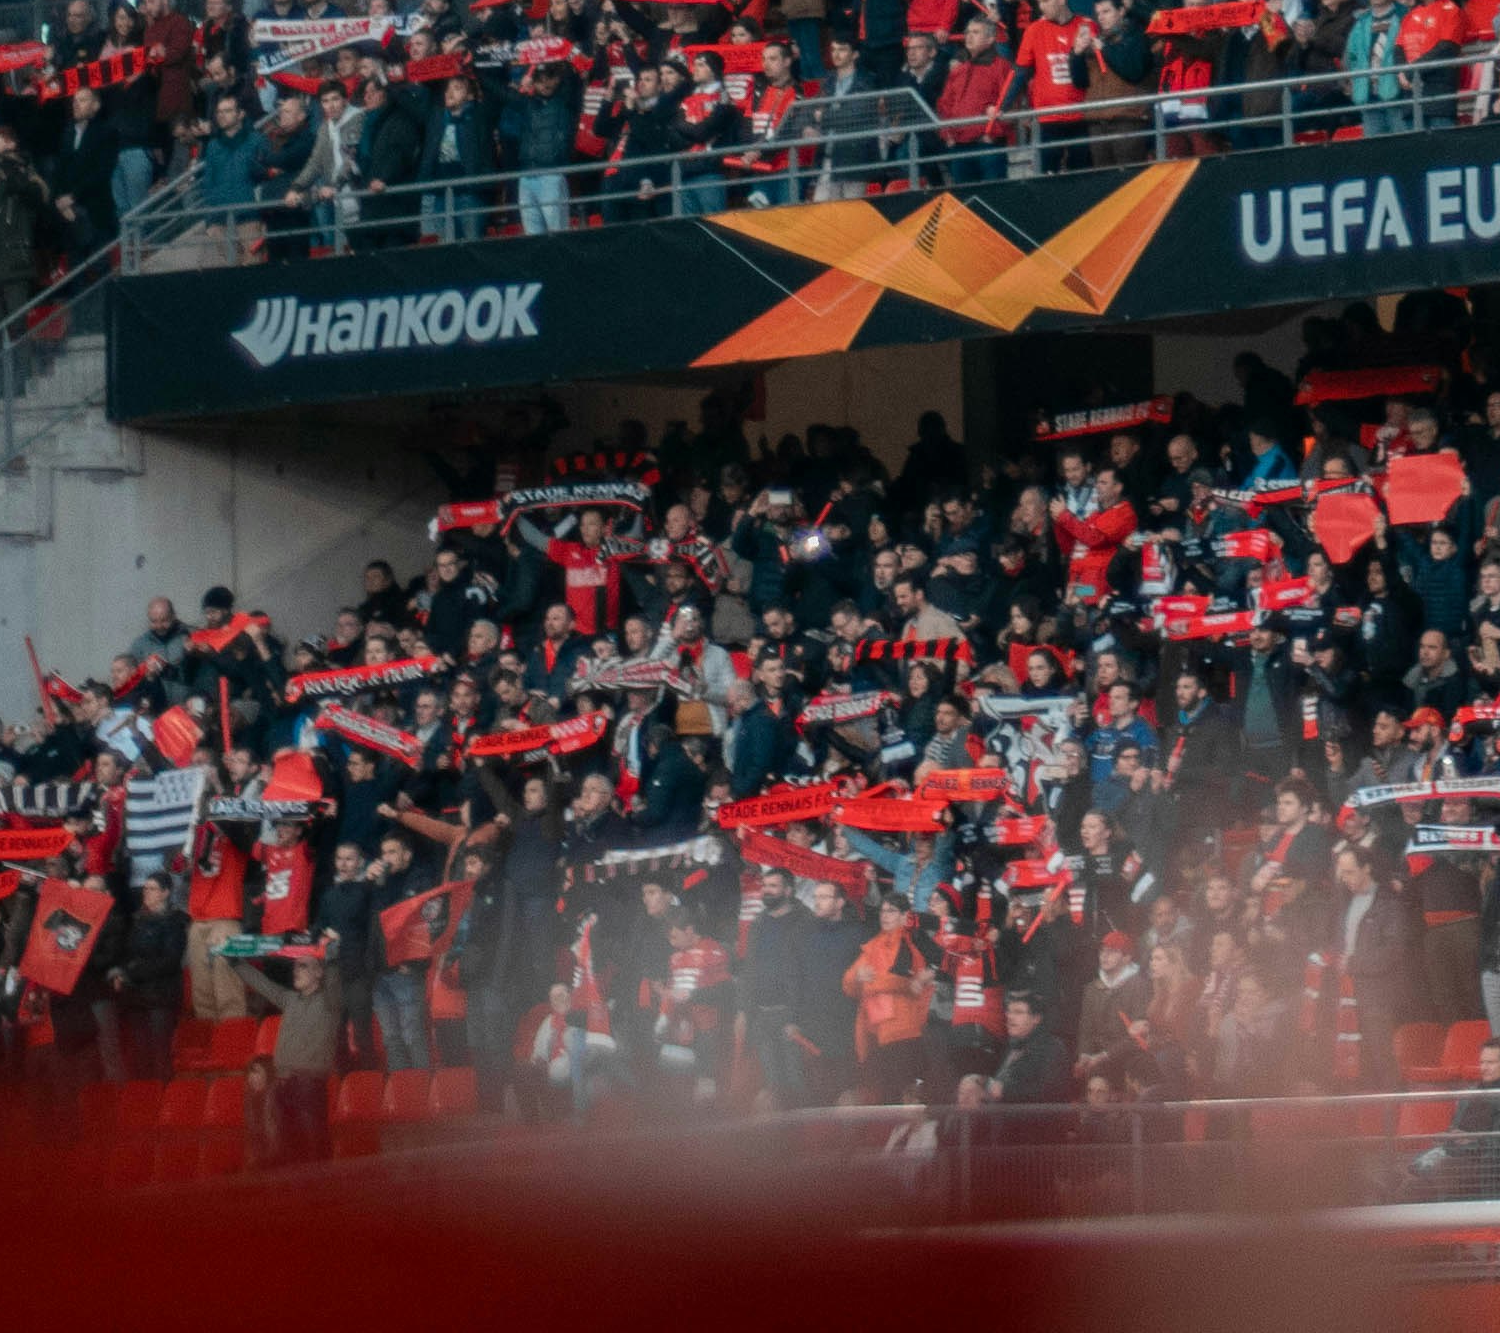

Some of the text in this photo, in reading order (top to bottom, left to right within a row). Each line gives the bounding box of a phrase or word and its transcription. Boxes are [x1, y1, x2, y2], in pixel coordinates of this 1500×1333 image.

[1240, 174, 1412, 263] UEFA
[514, 484, 568, 505] STADE
[722, 800, 760, 822] STADE
